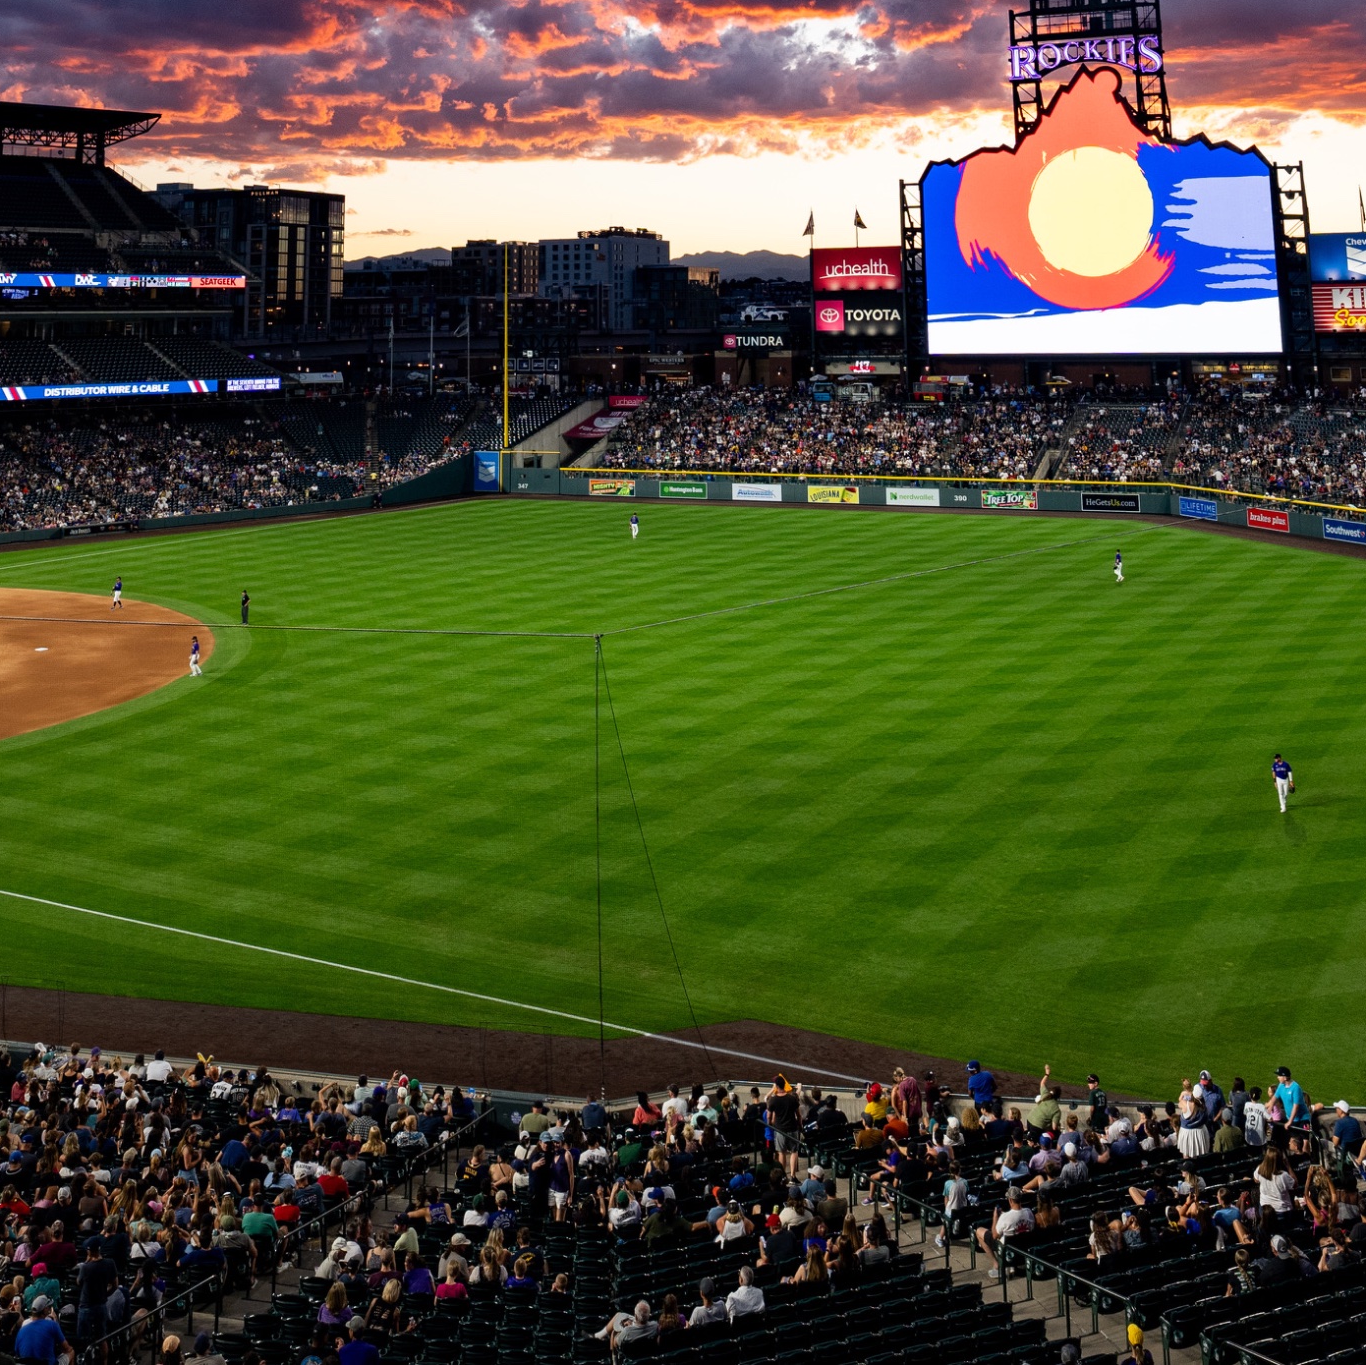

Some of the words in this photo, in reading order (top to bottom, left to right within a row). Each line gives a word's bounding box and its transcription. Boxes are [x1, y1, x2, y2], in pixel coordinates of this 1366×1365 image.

[1008, 36, 1163, 81] ROCKIES
[825, 258, 889, 276] uchealth
[200, 278, 235, 286] SEATGEEK
[845, 309, 901, 321] TOYOTA
[736, 336, 784, 347] TUNDRA
[44, 386, 107, 397] DISTRIBUTOR
[107, 385, 131, 395] WIRE
[139, 384, 169, 393] CABLE
[810, 490, 840, 502] LOUISIANA
[899, 493, 934, 501] nerdwallet
[987, 494, 1005, 504] TREE
[1006, 493, 1024, 503] TOP
[1086, 497, 1135, 507] HeGetsUs.com
[1186, 502, 1216, 513] LIFETIME
[1250, 512, 1271, 523] brakes
[1272, 515, 1287, 527] plus
[1325, 524, 1361, 538] Southwest
[1249, 1115, 1256, 1127] 2
